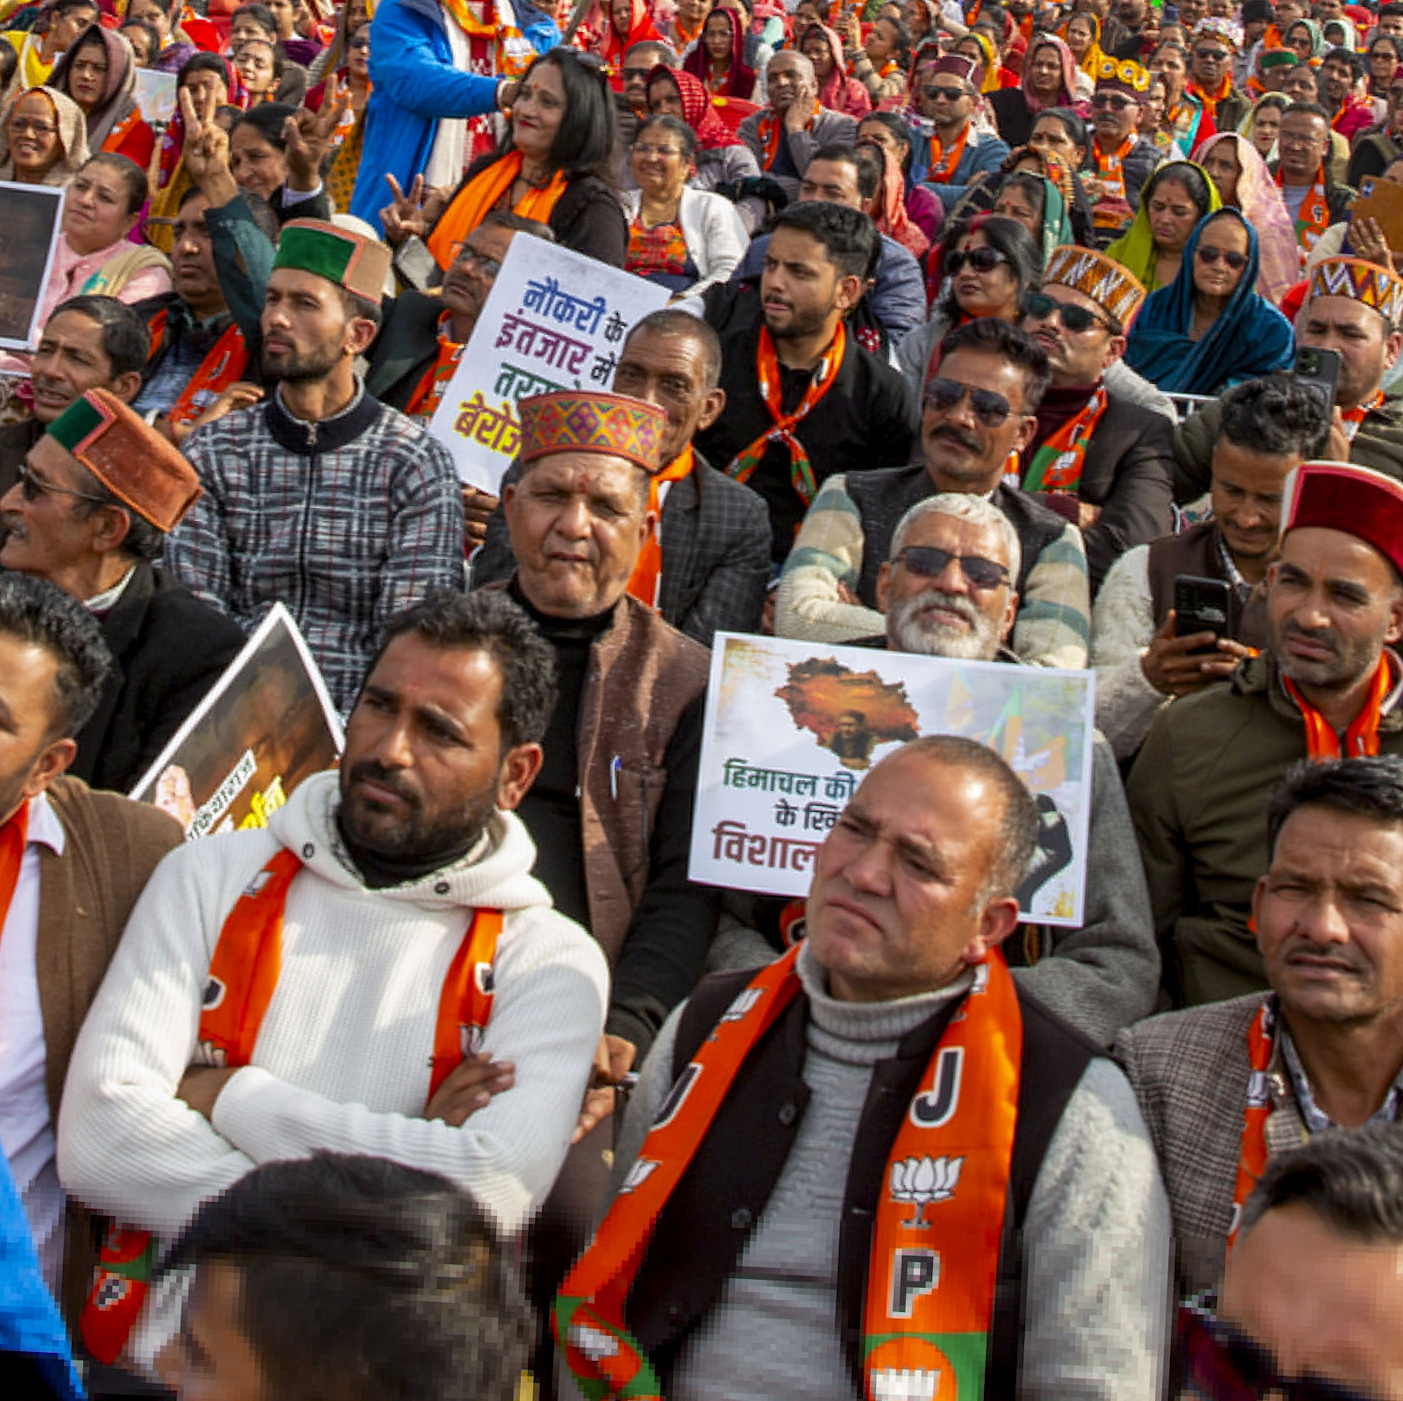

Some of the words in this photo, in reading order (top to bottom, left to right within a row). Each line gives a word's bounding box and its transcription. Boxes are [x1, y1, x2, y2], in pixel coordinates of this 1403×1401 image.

[522, 275, 607, 337] नौकरी
[495, 307, 596, 377] इंतजार
[722, 756, 818, 800] हिमाचल
[774, 798, 799, 828] के
[910, 1047, 964, 1129] J
[886, 1247, 941, 1320] P
